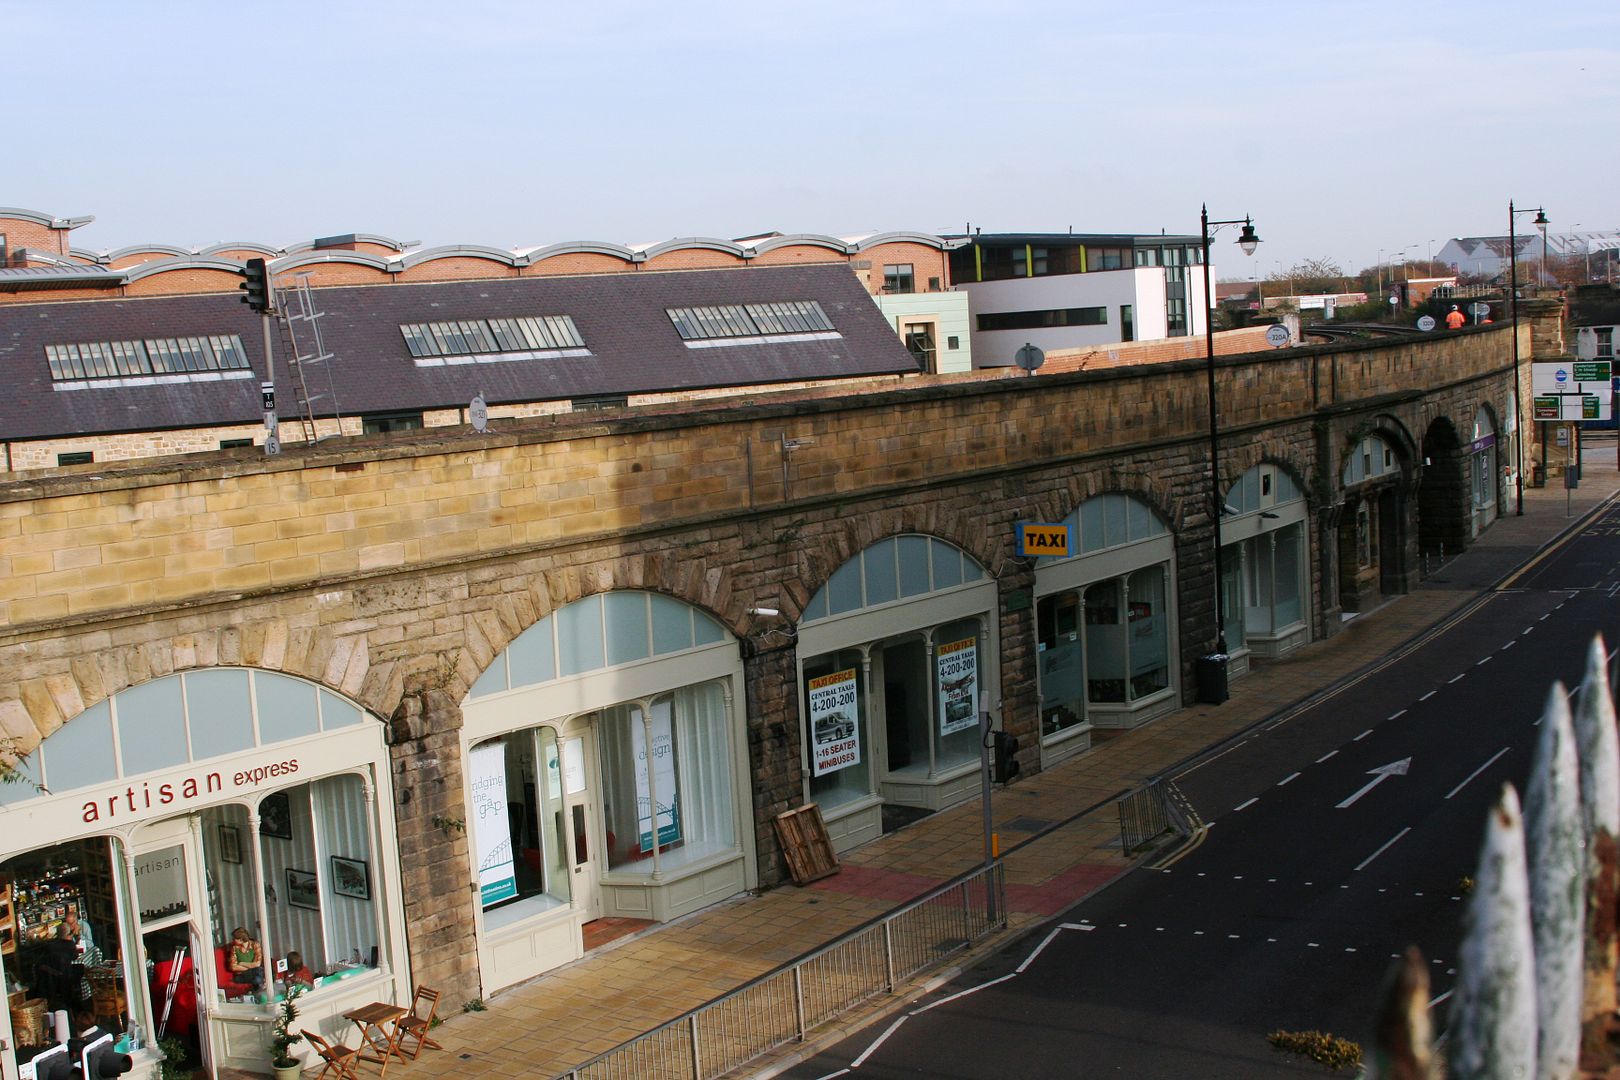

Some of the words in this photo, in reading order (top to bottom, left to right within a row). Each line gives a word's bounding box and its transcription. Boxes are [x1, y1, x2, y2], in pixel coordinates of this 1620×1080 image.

[268, 442, 277, 454] 15
[1026, 533, 1066, 548] TAXI
[953, 638, 974, 652] OFFICE
[939, 654, 961, 666] CENTRAL
[940, 658, 975, 678] 4-200-200
[812, 678, 829, 689] TAXI
[829, 670, 853, 684] OFFICE
[811, 689, 837, 701] CENTRAL
[837, 683, 854, 693] TAXIS
[812, 691, 855, 713] 4-200-200
[815, 747, 830, 759] 1-16
[830, 740, 856, 755] SEATER
[818, 752, 855, 771] MINIBUSES
[82, 772, 222, 823] artisan
[233, 758, 299, 786] express
[473, 791, 486, 803] the
[134, 857, 179, 877] artisan
